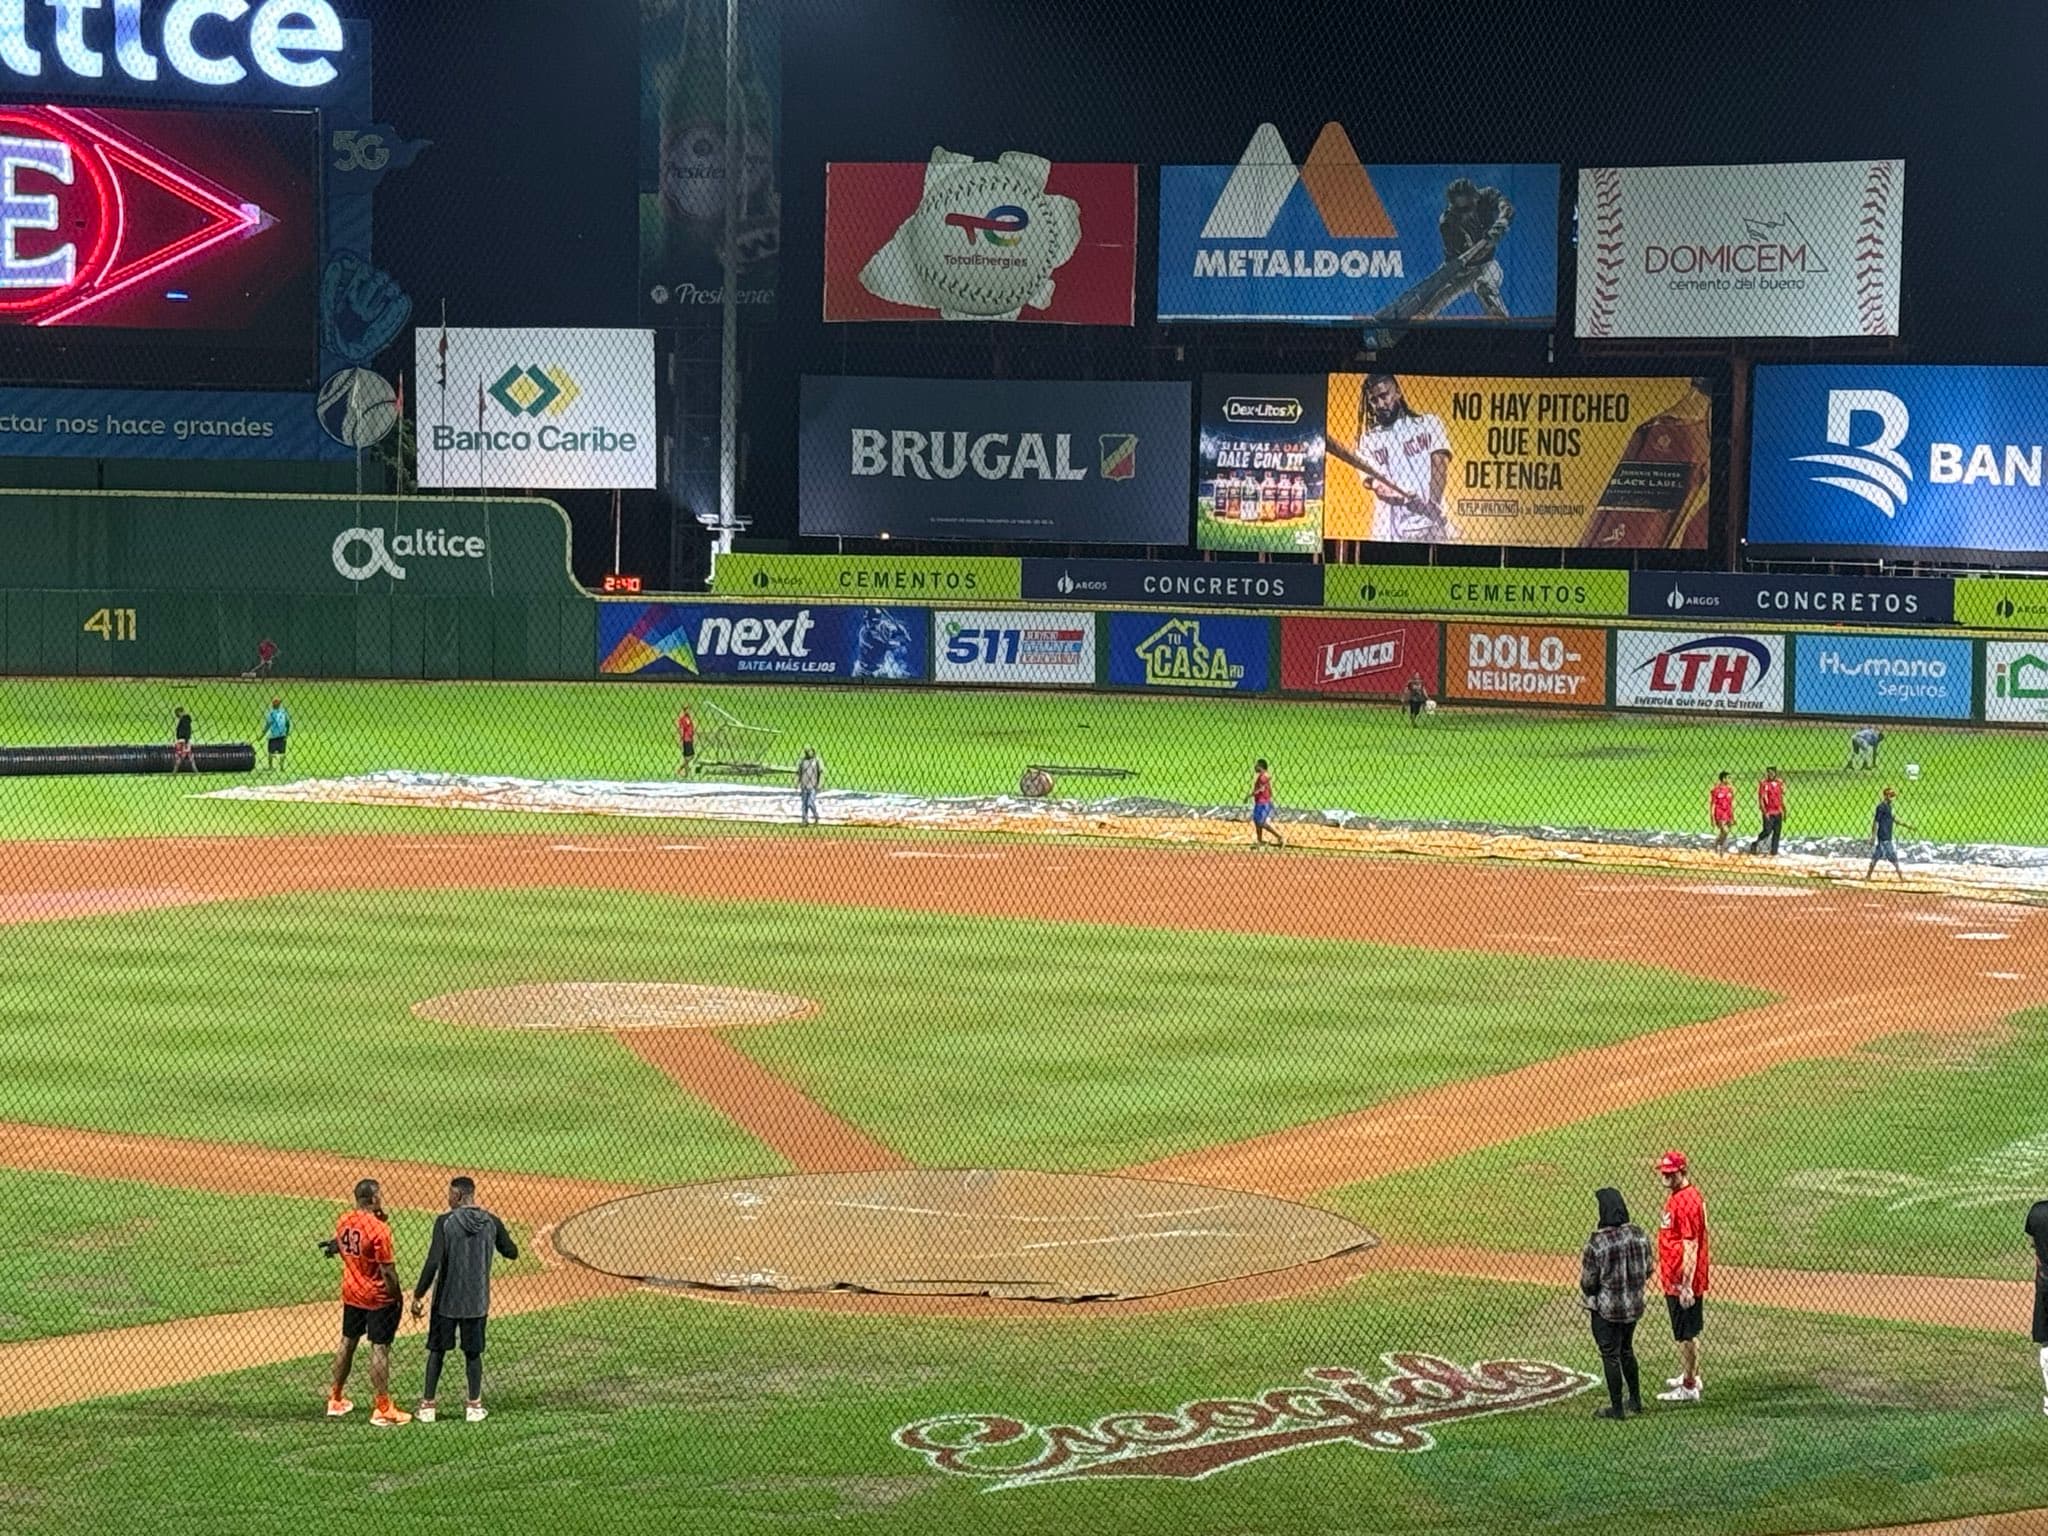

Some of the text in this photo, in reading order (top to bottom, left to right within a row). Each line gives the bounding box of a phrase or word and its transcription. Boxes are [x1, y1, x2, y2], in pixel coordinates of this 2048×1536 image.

[332, 130, 391, 172] 5G
[944, 254, 1028, 269] TotalEnergies
[1193, 249, 1404, 279] METALDOM
[1645, 243, 1808, 274] DOMICEM
[675, 282, 776, 305] Presiente
[1669, 277, 1805, 291] cemento del bueno
[1453, 393, 1630, 423] NO HAY PITCHEO
[56, 417, 98, 434] nos
[106, 415, 166, 435] hace
[173, 417, 273, 441] grandes
[433, 425, 637, 453] Banco Caribe
[850, 428, 1088, 480] BRUGAL
[1488, 427, 1581, 458] QUE NOS
[1465, 461, 1564, 491] DETENGA
[1930, 443, 2043, 487] BAN
[391, 529, 486, 558] altice
[603, 576, 642, 593] 2:40
[839, 571, 977, 589] CEMENTOS
[1075, 580, 1107, 591] ARGOS
[1143, 576, 1285, 596] CONCRETOS
[1450, 583, 1587, 603] CEMENTOS
[1686, 596, 1720, 606] ARGOS
[1756, 591, 1919, 613] CONCRETOS
[84, 608, 136, 640] 411
[696, 610, 815, 657] next
[946, 630, 1022, 664] 511
[1167, 633, 1182, 644] TU
[1468, 633, 1582, 671] DOLO-
[737, 659, 836, 672] BATEA MÁS LEJOS
[1153, 644, 1229, 679] CASA
[1324, 640, 1396, 679] LANCO
[1650, 652, 1750, 694] LTH
[1819, 652, 1946, 679] Humano
[1467, 670, 1580, 695] NEUROMEY
[1877, 679, 1947, 699] Seguros
[341, 1228, 361, 1256] 43
